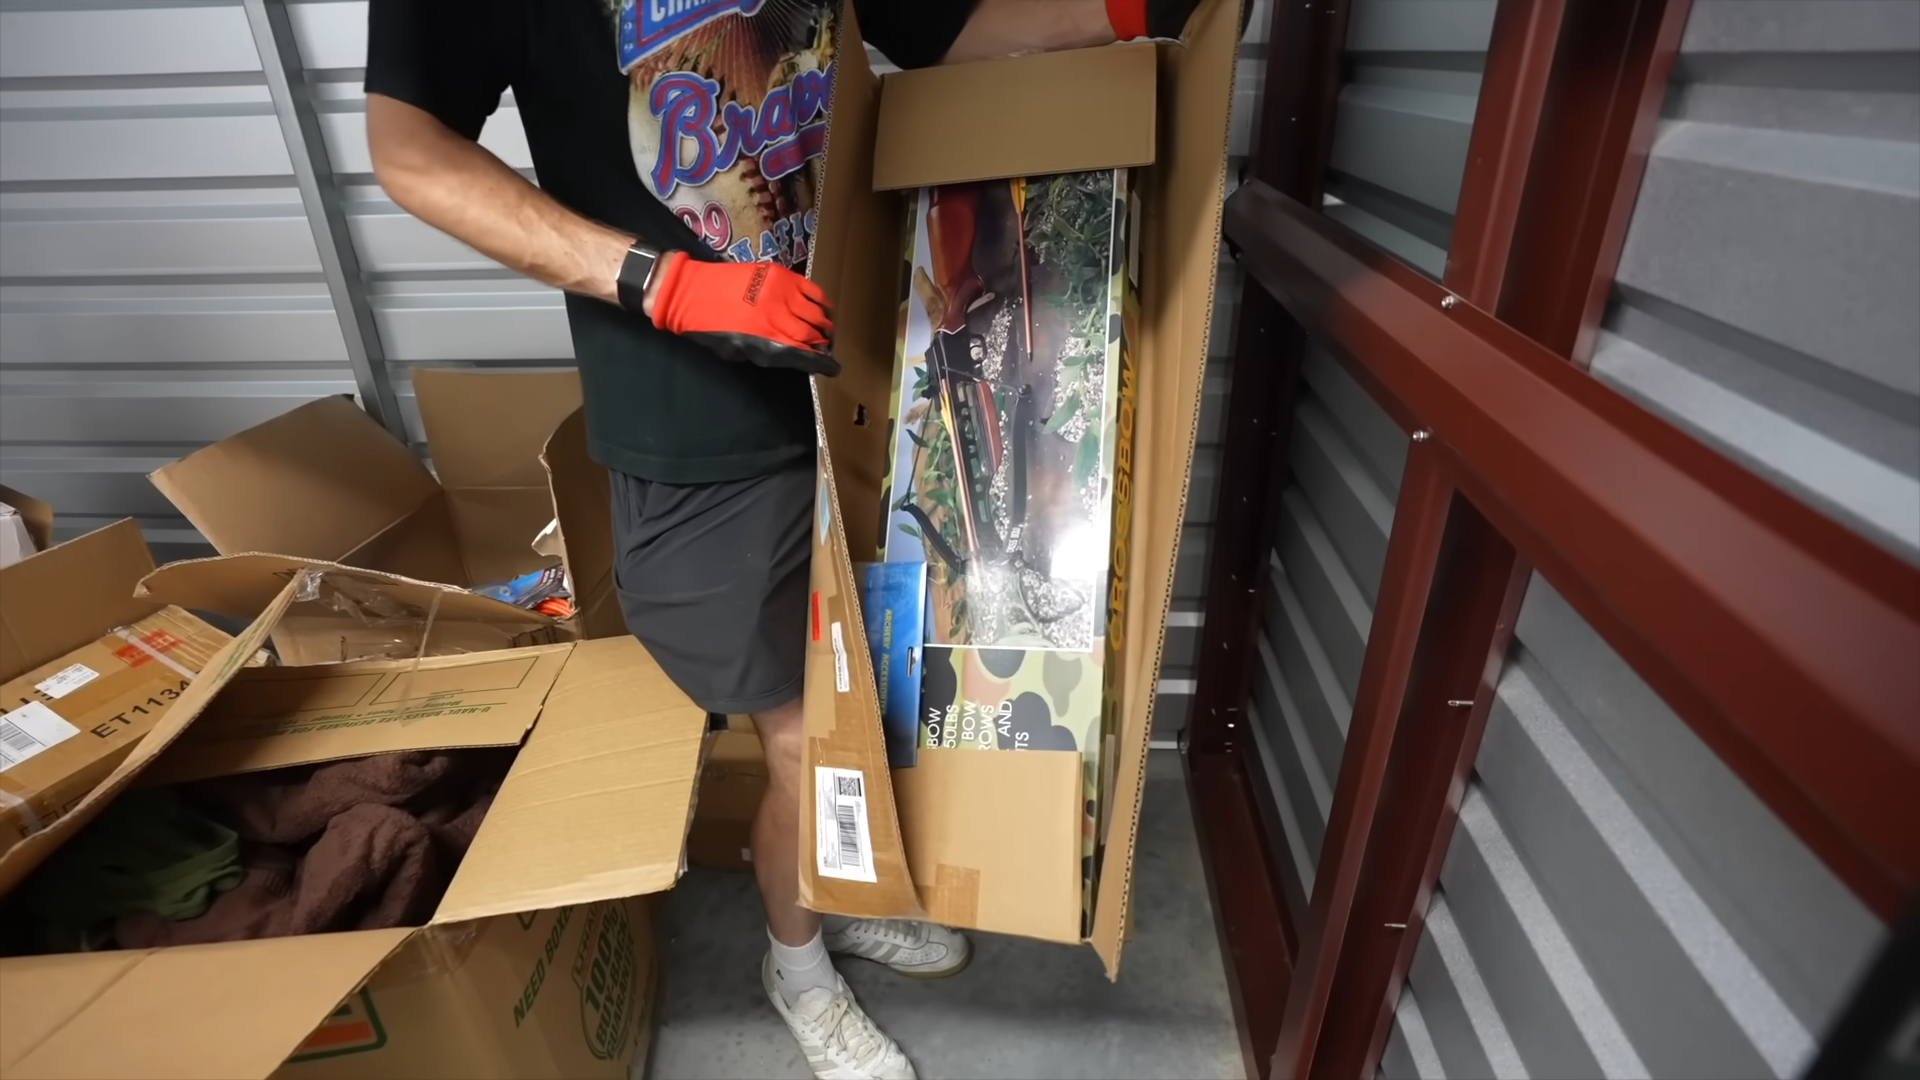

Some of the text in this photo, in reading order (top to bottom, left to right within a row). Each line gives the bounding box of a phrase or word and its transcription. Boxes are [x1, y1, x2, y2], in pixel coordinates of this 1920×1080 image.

[1110, 351, 1137, 651] CROSSBOW
[883, 609, 893, 649] ARCHERY
[926, 707, 941, 749] BOW
[961, 700, 977, 740] BOW
[998, 701, 1013, 737] AND
[1014, 731, 1029, 751] TS
[585, 906, 618, 1013] 100%
[513, 957, 545, 1028] NEED
[596, 914, 627, 1048] BUY-BACK
